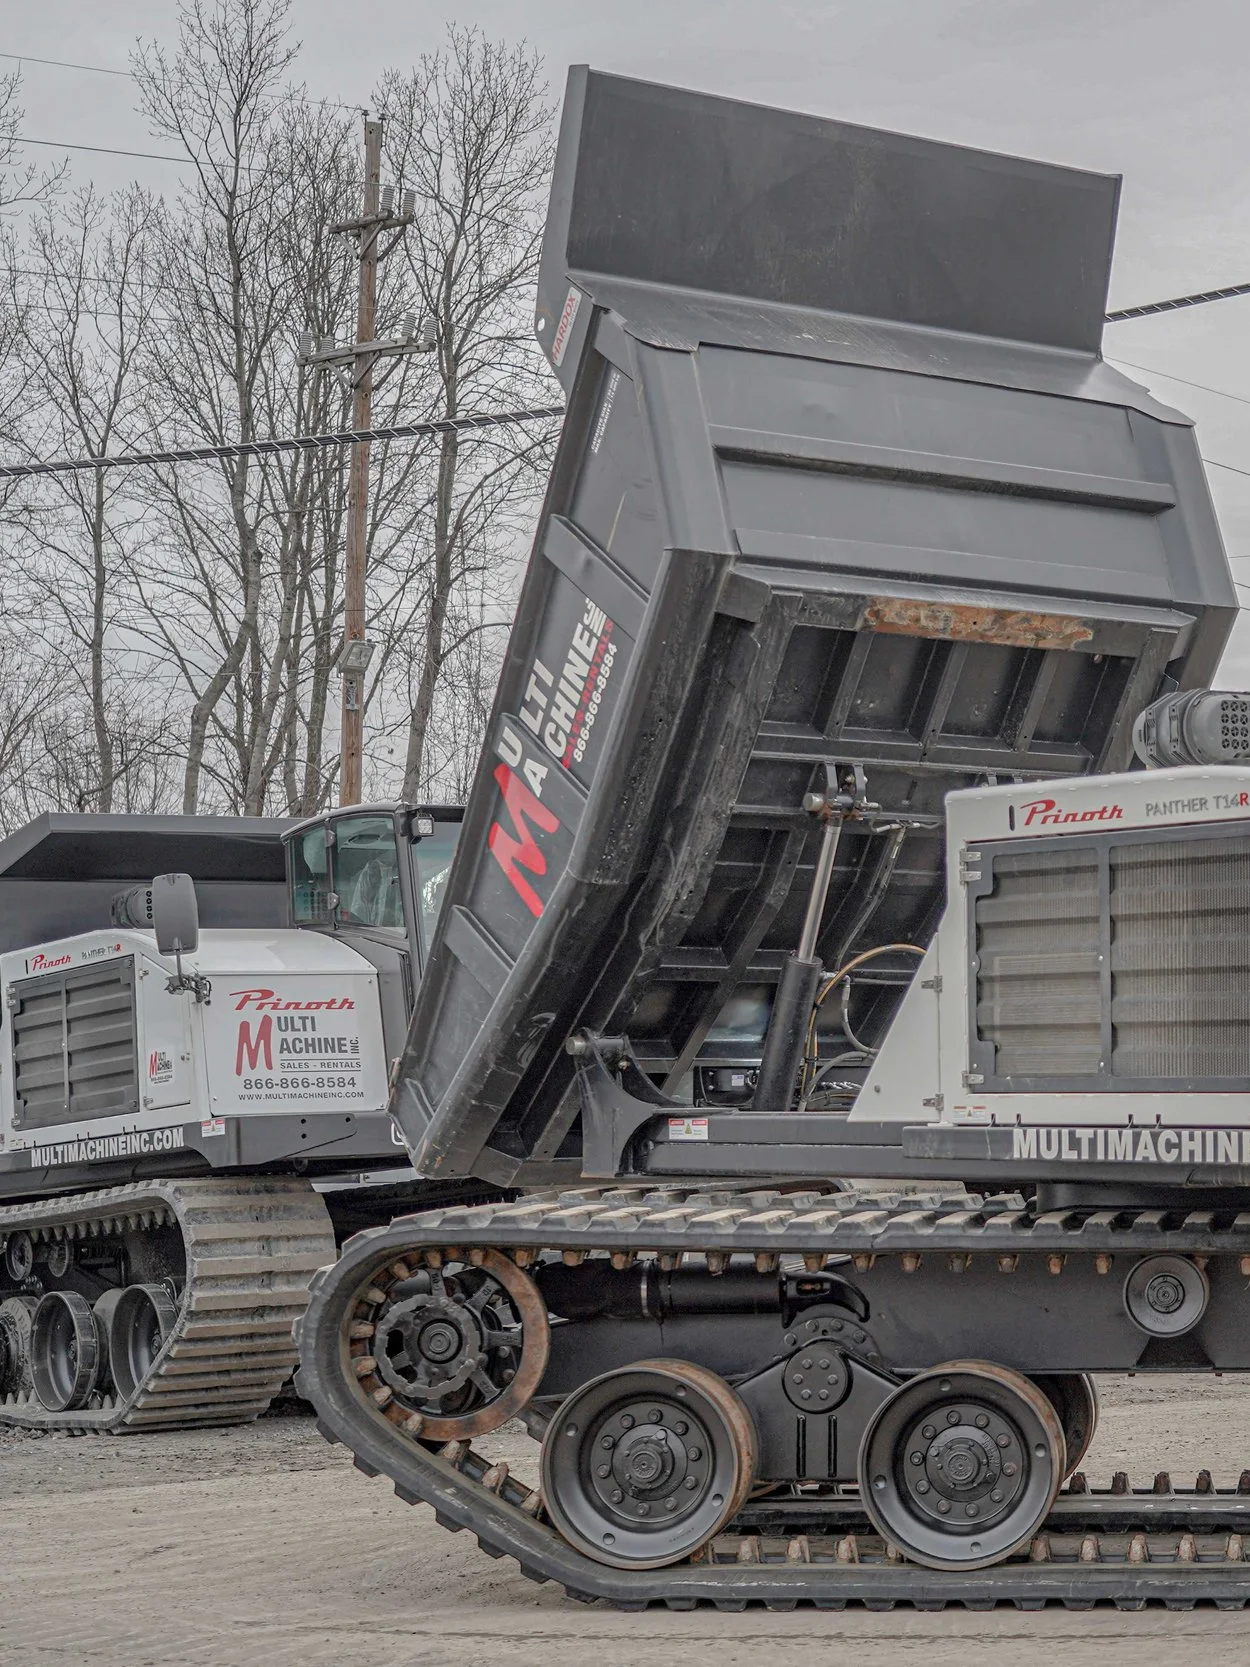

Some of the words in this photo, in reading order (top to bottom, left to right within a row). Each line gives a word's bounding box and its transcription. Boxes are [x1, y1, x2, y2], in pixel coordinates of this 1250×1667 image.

[552, 296, 576, 362] HARDOX
[573, 642, 618, 763] 866-866-8584
[1020, 799, 1123, 826] Prinoth
[1146, 798, 1209, 817] PANTHER
[1213, 792, 1250, 811] T14R
[31, 953, 72, 971] Prinoth
[229, 989, 355, 1011] Prinoth
[349, 1036, 360, 1054] INC.
[280, 1062, 310, 1070] SALES
[320, 1061, 361, 1069] RENTALS
[243, 1076, 356, 1090] 866-866-8584
[238, 1091, 364, 1101] WWW.MULTIMACHINEINC.COM
[31, 1126, 185, 1168] MULTIMACHINEINC.COM
